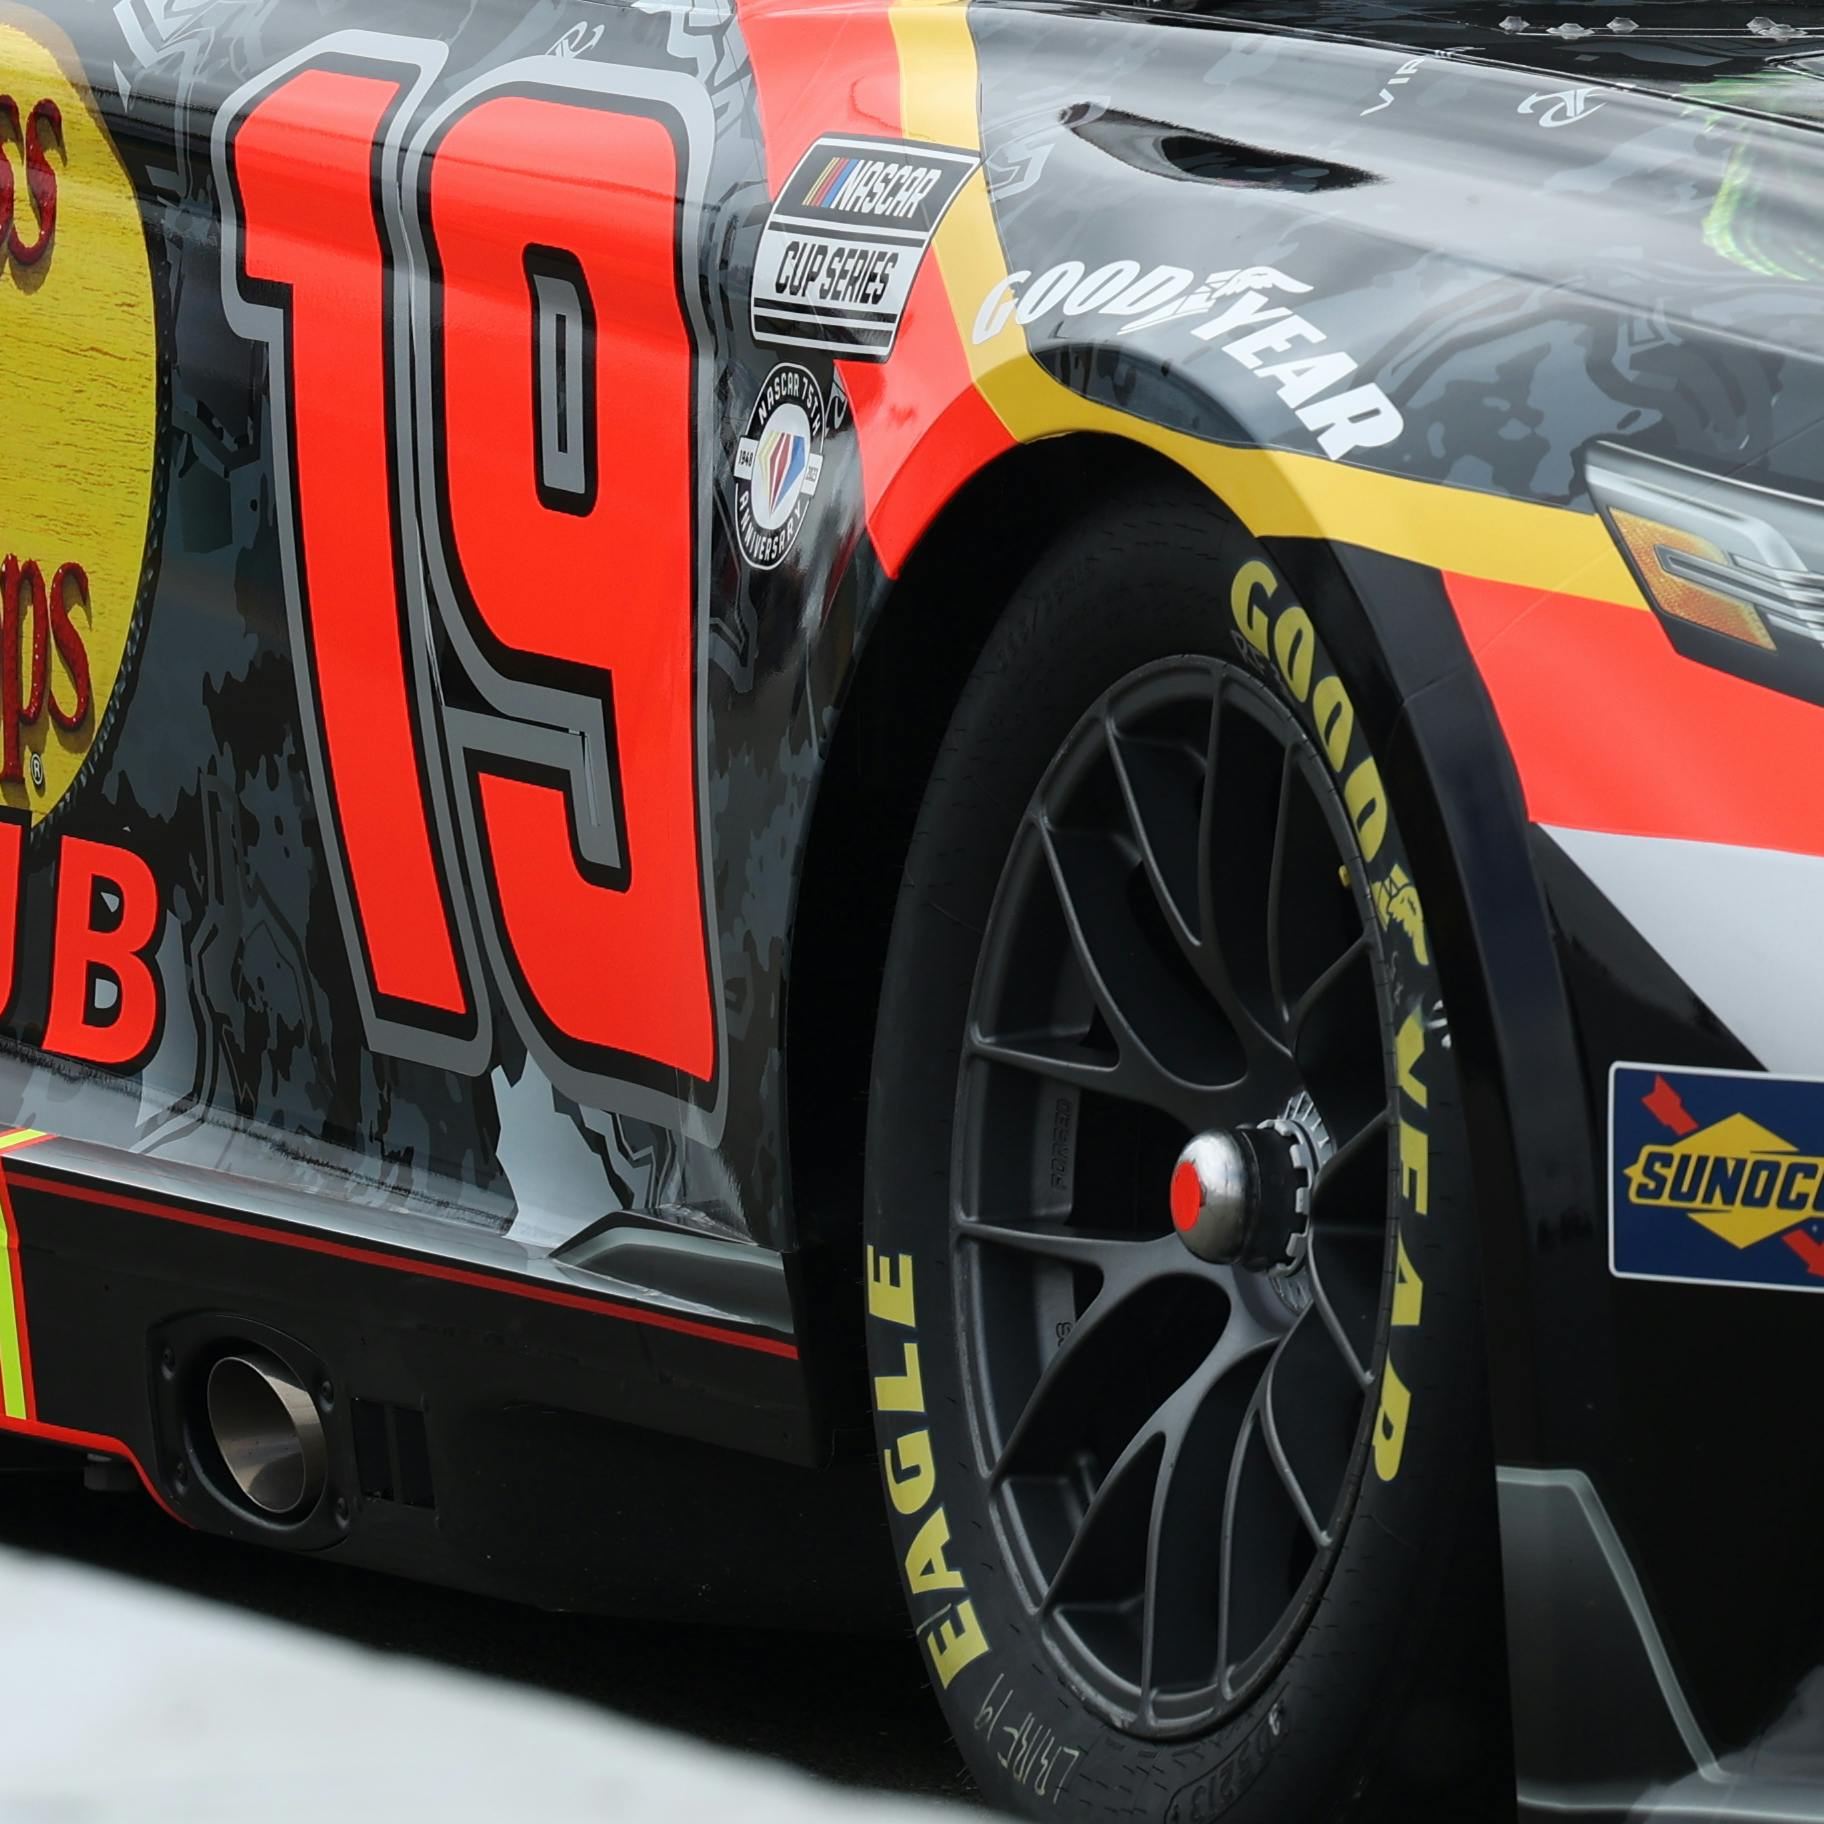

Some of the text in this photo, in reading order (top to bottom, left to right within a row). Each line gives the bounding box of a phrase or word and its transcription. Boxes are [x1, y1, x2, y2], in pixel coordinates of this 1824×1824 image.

[830, 159, 942, 218] NASCAR
[775, 241, 899, 305] CUP SERIES
[758, 372, 821, 436] NASCAR 75TH
[740, 490, 801, 561] ANNIVERSARY
[218, 46, 722, 1106] 19
[867, 1244, 989, 1691] EAGLE
